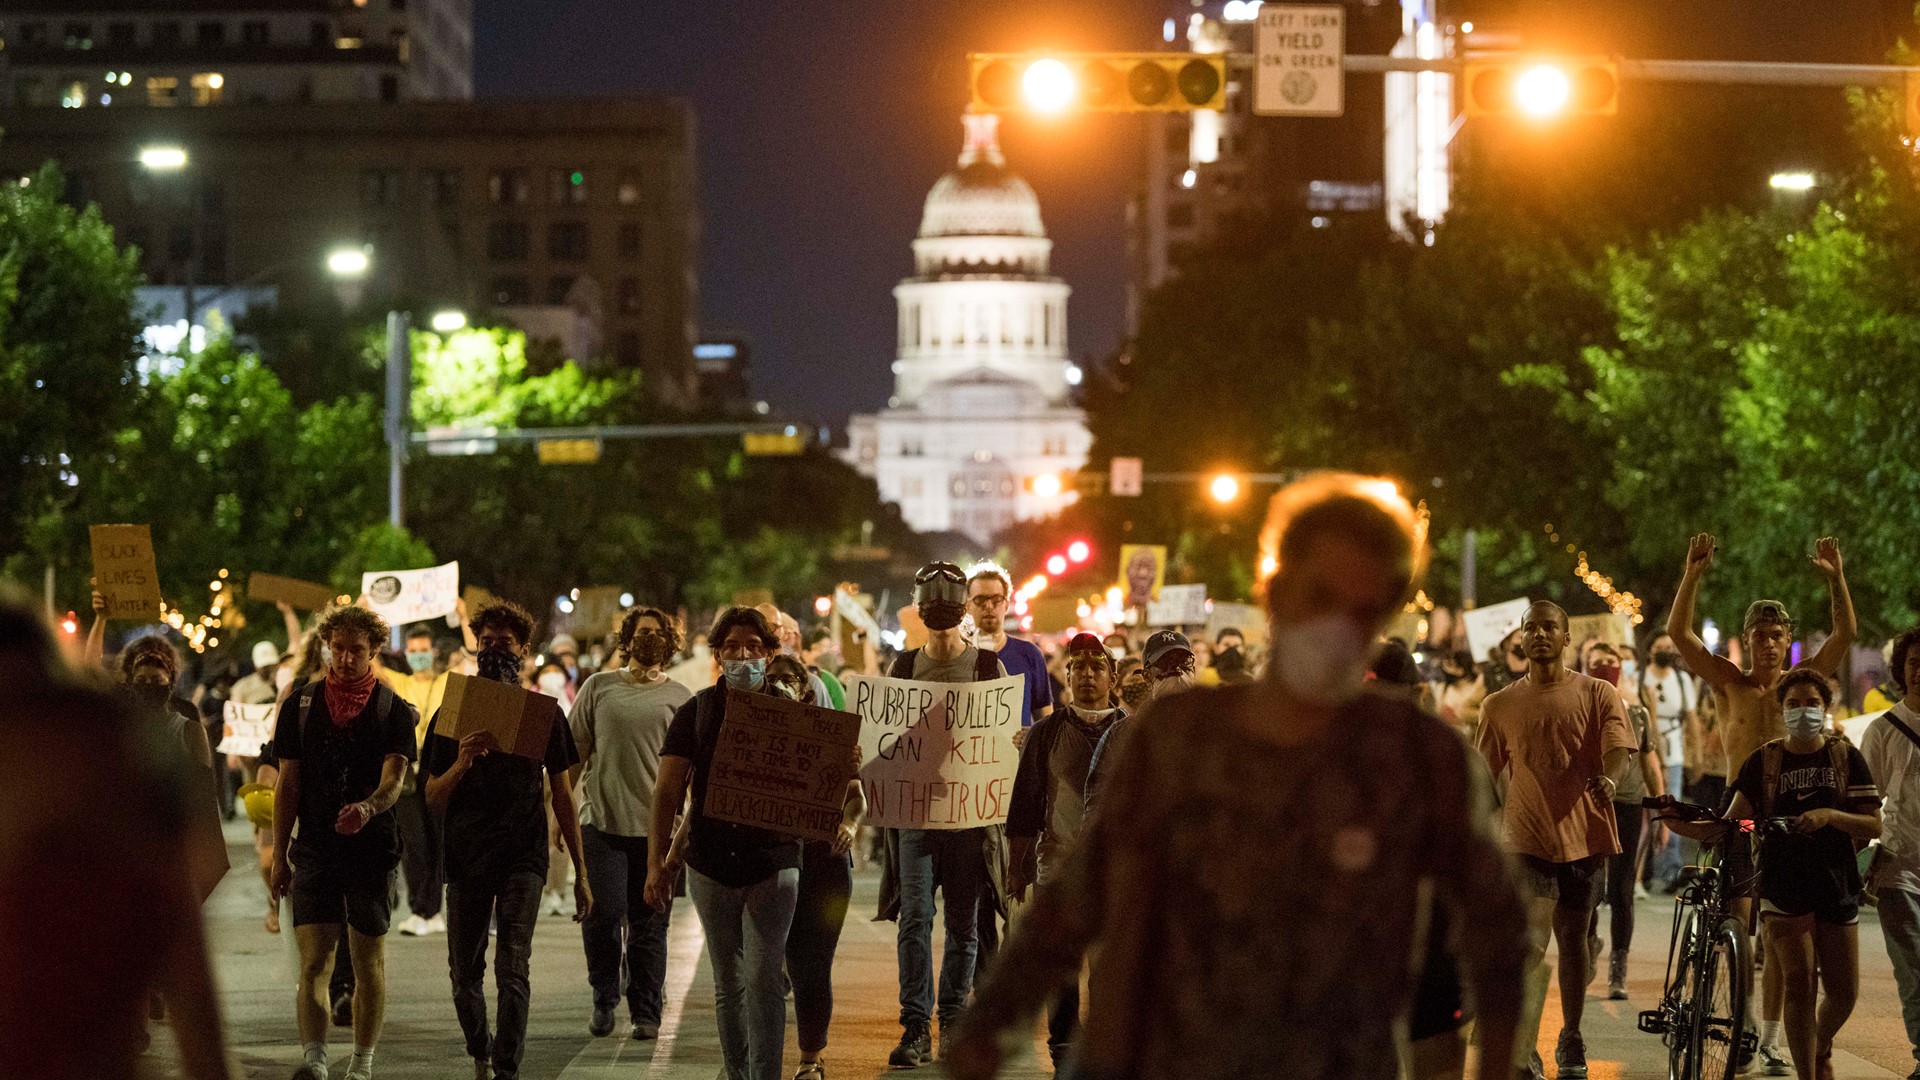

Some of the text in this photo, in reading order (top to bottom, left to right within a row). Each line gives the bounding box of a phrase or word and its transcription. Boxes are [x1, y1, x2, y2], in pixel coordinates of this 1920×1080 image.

[1261, 14, 1338, 27] LEFT TURN
[1277, 32, 1324, 49] YIELD
[1262, 54, 1335, 68] ON GREEN
[103, 569, 147, 585] LIVES
[733, 692, 752, 705] NO
[804, 708, 821, 718] NO
[856, 681, 1014, 731] RUBBER BULLETS
[724, 727, 822, 760] NOW IS NOT
[878, 732, 1000, 765] CAN KILL
[733, 747, 754, 764] THE
[762, 751, 791, 768] TIME
[1780, 768, 1836, 794] NIKE
[895, 778, 969, 823] THEIR
[975, 777, 1010, 820] USE
